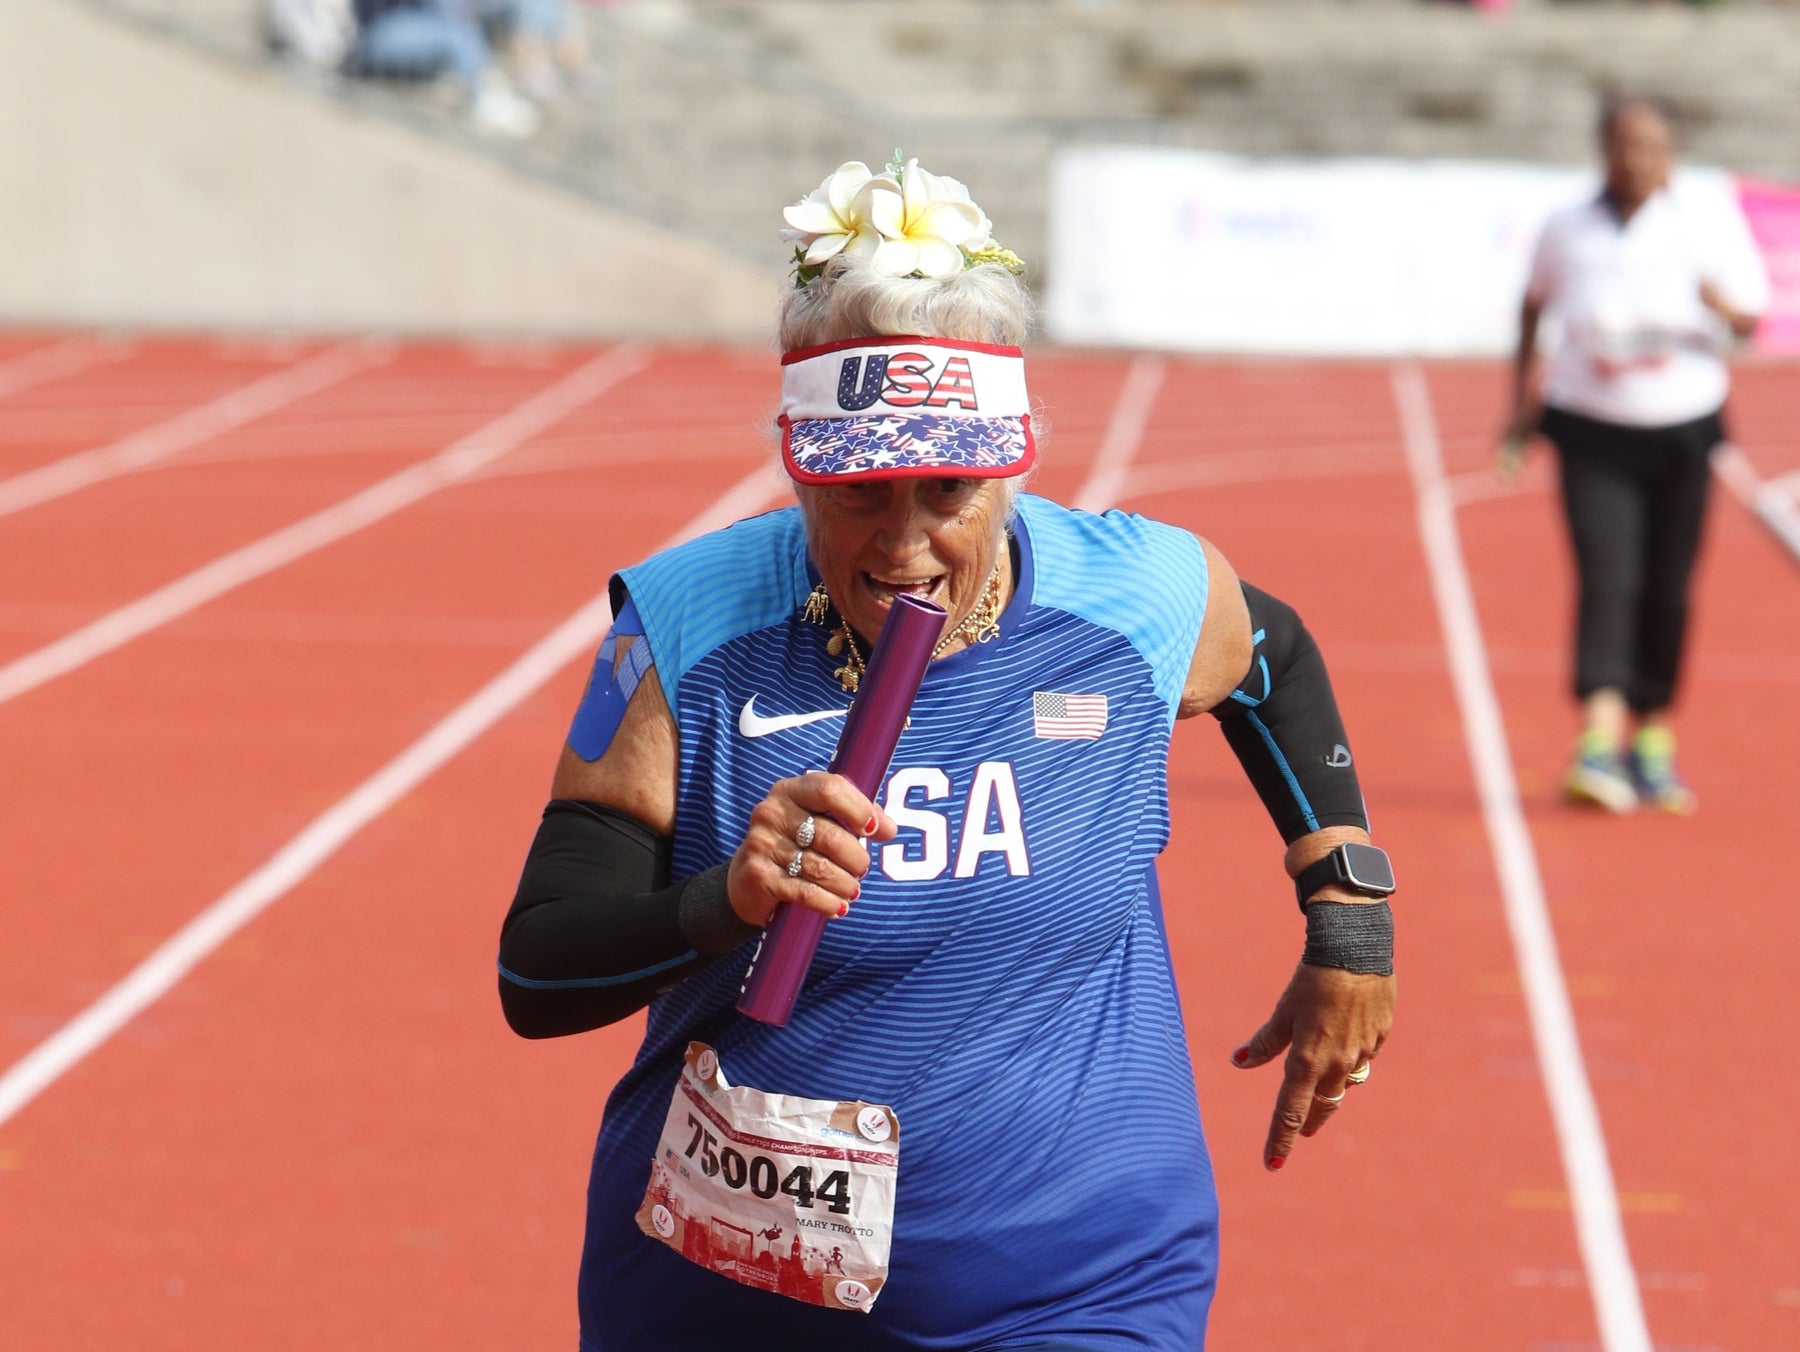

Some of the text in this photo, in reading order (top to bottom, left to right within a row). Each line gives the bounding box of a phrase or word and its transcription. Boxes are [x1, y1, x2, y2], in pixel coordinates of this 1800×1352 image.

[837, 352, 978, 411] USA
[806, 761, 1031, 881] SA
[685, 1111, 851, 1215] 750044
[795, 1217, 874, 1238] MARY TROTTO
